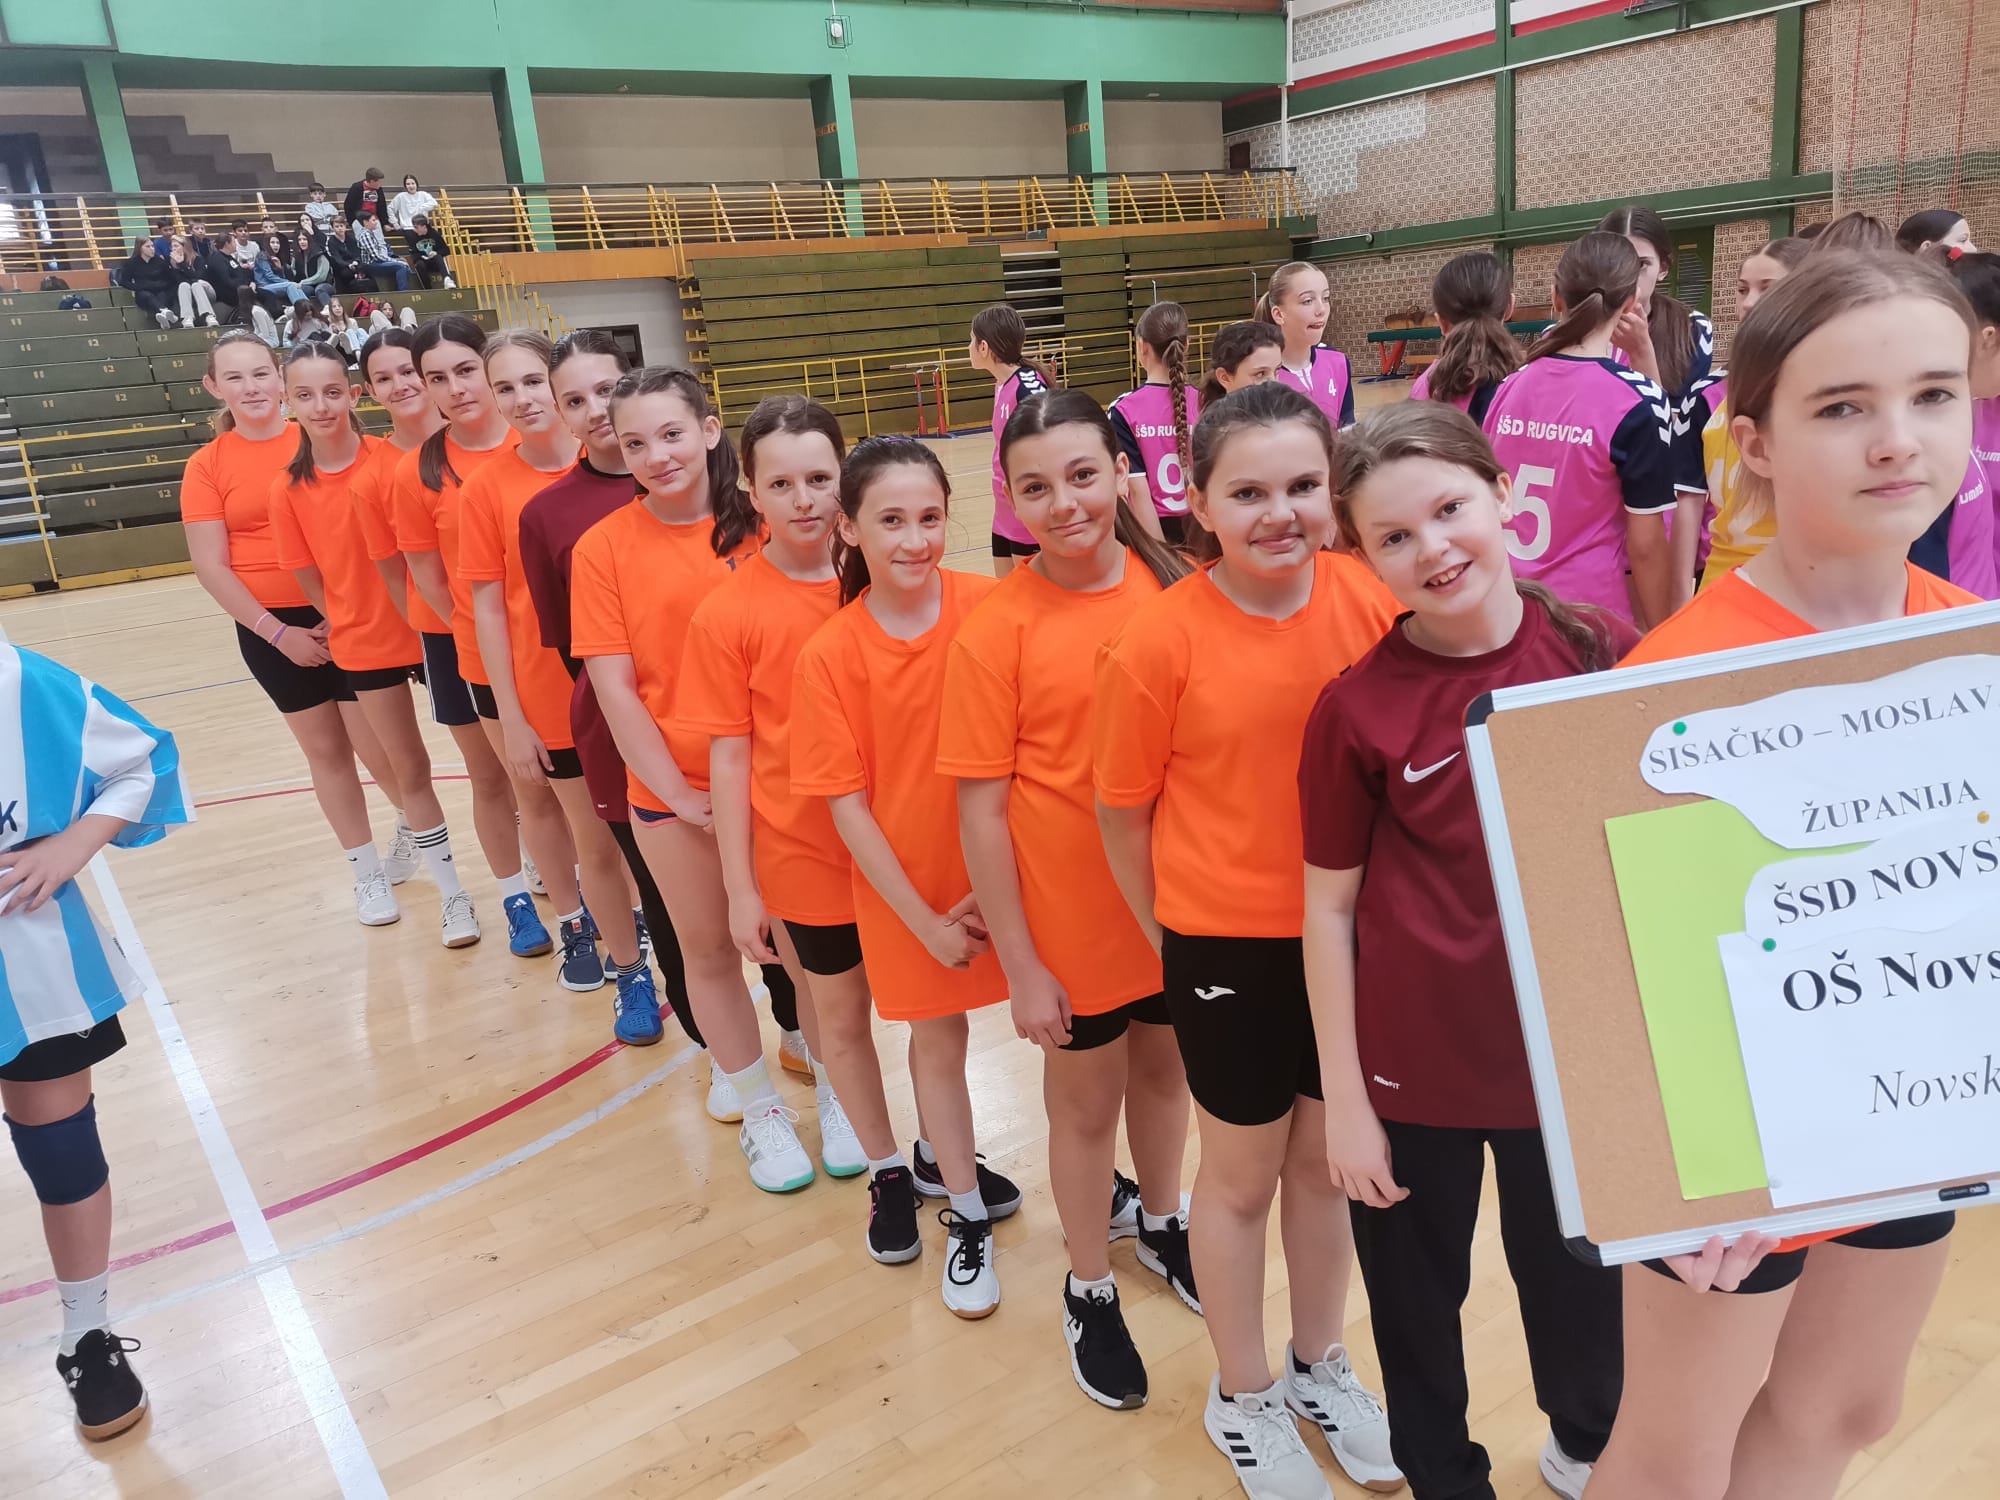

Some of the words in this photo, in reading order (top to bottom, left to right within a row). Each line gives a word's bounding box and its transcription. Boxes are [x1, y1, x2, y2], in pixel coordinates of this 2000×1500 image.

[11, 317, 22, 326] 11
[77, 313, 89, 322] 12
[20, 344, 31, 352] 11
[88, 338, 100, 347] 12
[33, 370, 45, 379] 11
[1328, 378, 1337, 397] 4
[42, 400, 54, 408] 11
[1000, 403, 1010, 420] 11
[1526, 420, 1594, 446] RUGVICA
[1157, 453, 1188, 511] 9
[1502, 463, 1556, 561] 5
[1648, 723, 1804, 774] SISAČKO
[1840, 684, 1992, 738] MOSLAV
[1801, 778, 1981, 834] ŽUPANIJA
[1773, 881, 1857, 926] ŠSD
[1867, 836, 2000, 901] NOVS
[1782, 948, 1863, 1012] OŠ
[1866, 1053, 2000, 1115] Novsk
